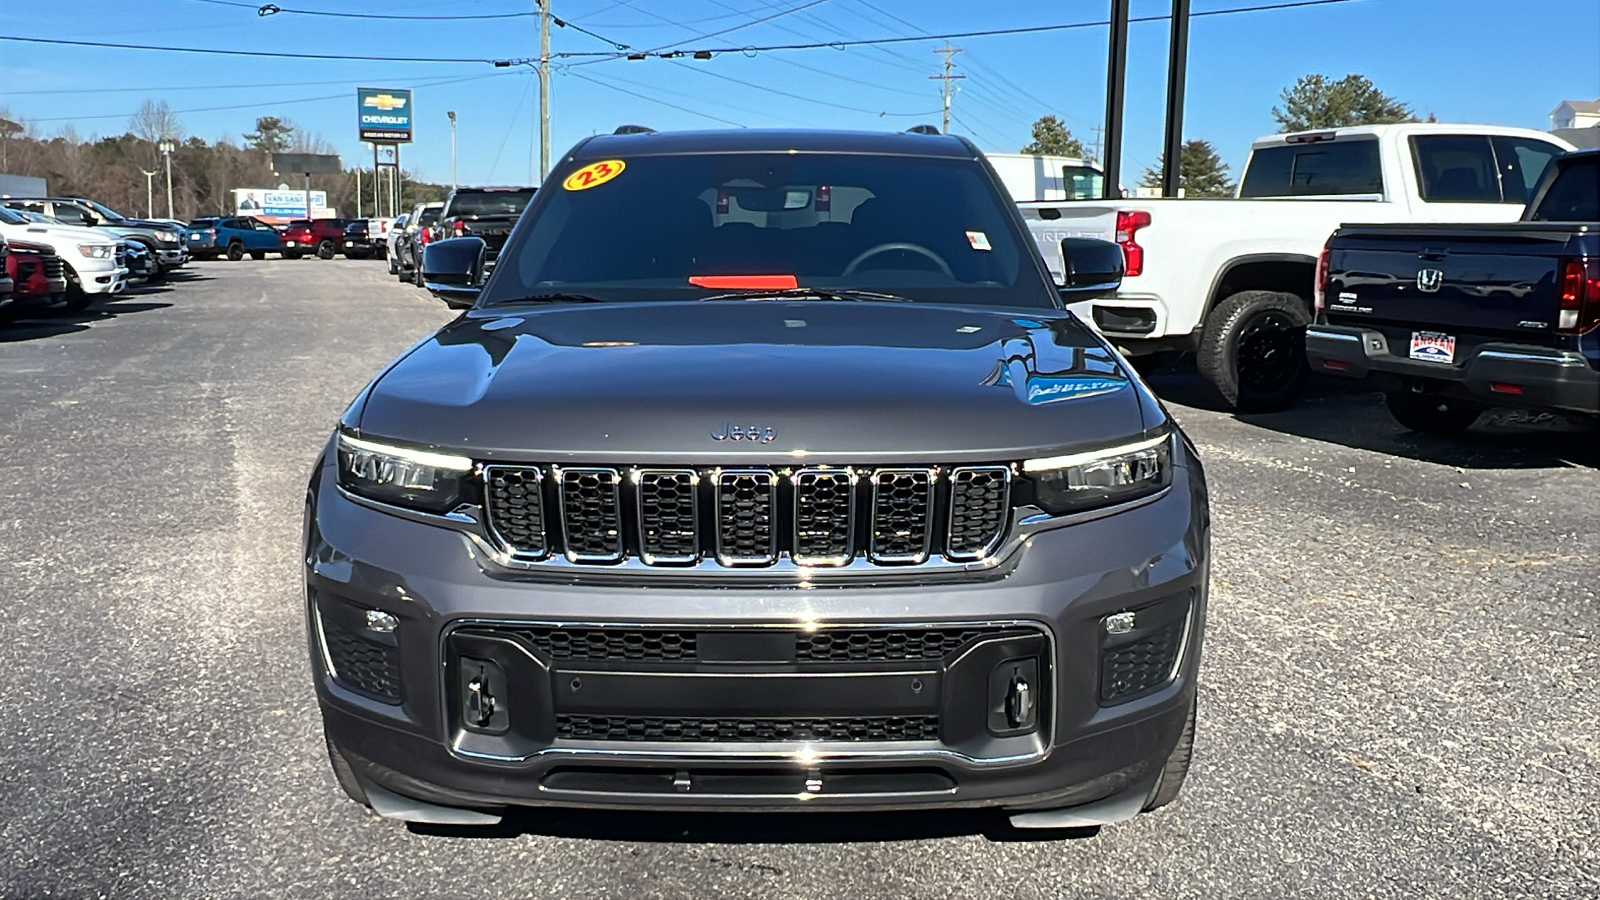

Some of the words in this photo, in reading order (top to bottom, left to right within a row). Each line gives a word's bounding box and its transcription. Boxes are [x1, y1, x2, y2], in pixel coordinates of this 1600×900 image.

[362, 115, 408, 124] CHEVROLET
[576, 163, 613, 187] 23
[471, 228, 513, 236] CHEV
[1413, 334, 1454, 353] ANDEAN
[711, 421, 778, 444] Jeep
